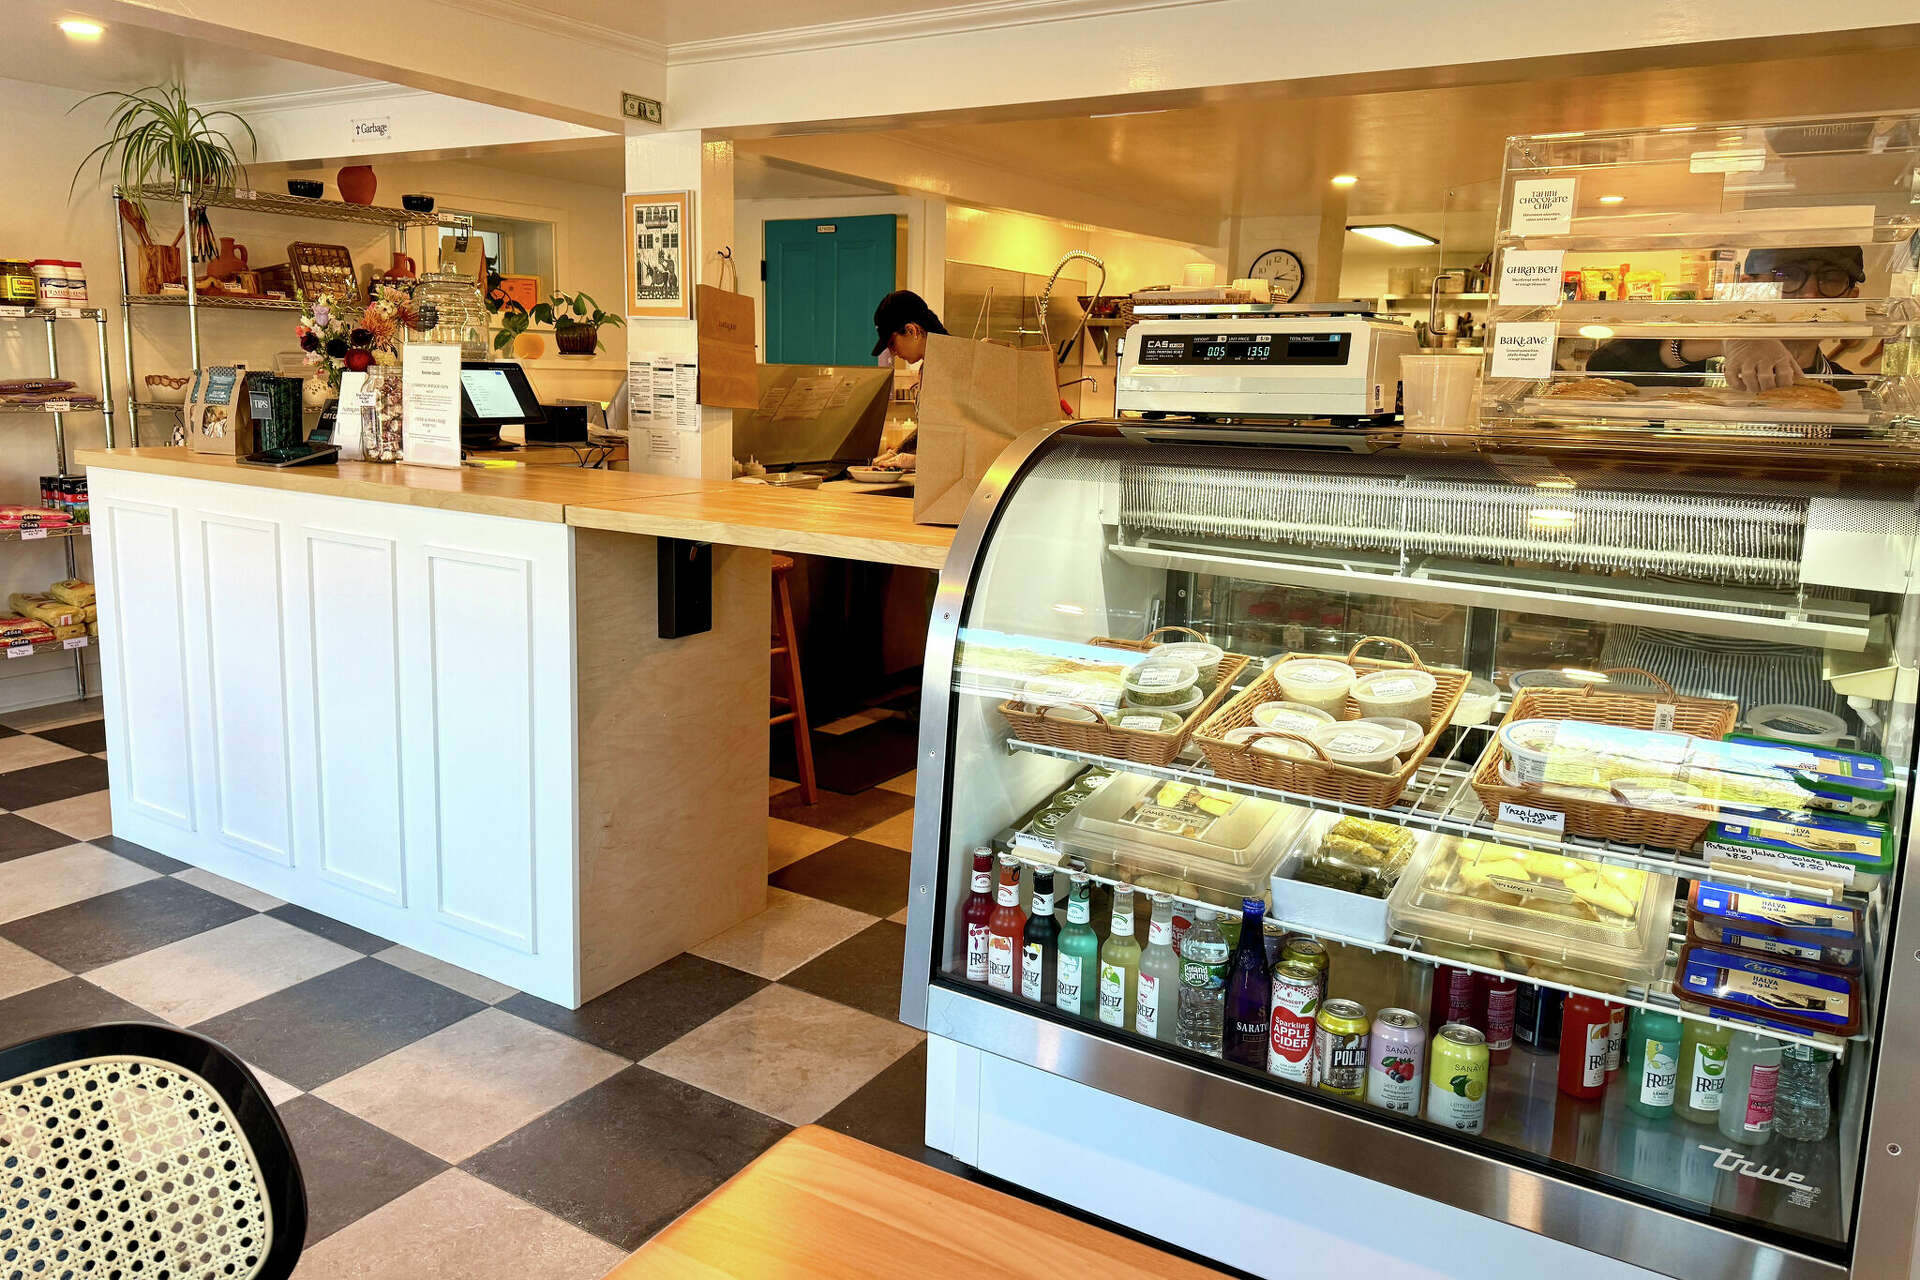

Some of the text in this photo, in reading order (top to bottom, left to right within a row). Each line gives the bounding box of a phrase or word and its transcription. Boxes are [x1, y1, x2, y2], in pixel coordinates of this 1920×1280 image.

[361, 122, 387, 136] Garbage
[1147, 340, 1169, 348] CAS
[253, 399, 269, 409] TIPS
[1762, 900, 1787, 910] HALVA
[1184, 964, 1208, 975] Poland
[1185, 973, 1209, 985] Spring
[1753, 975, 1779, 987] HALVA
[1275, 1016, 1310, 1031] Sparkling
[1273, 1025, 1311, 1039] APPLE
[1273, 1033, 1309, 1048] CIDER
[1334, 1050, 1365, 1067] POLAR
